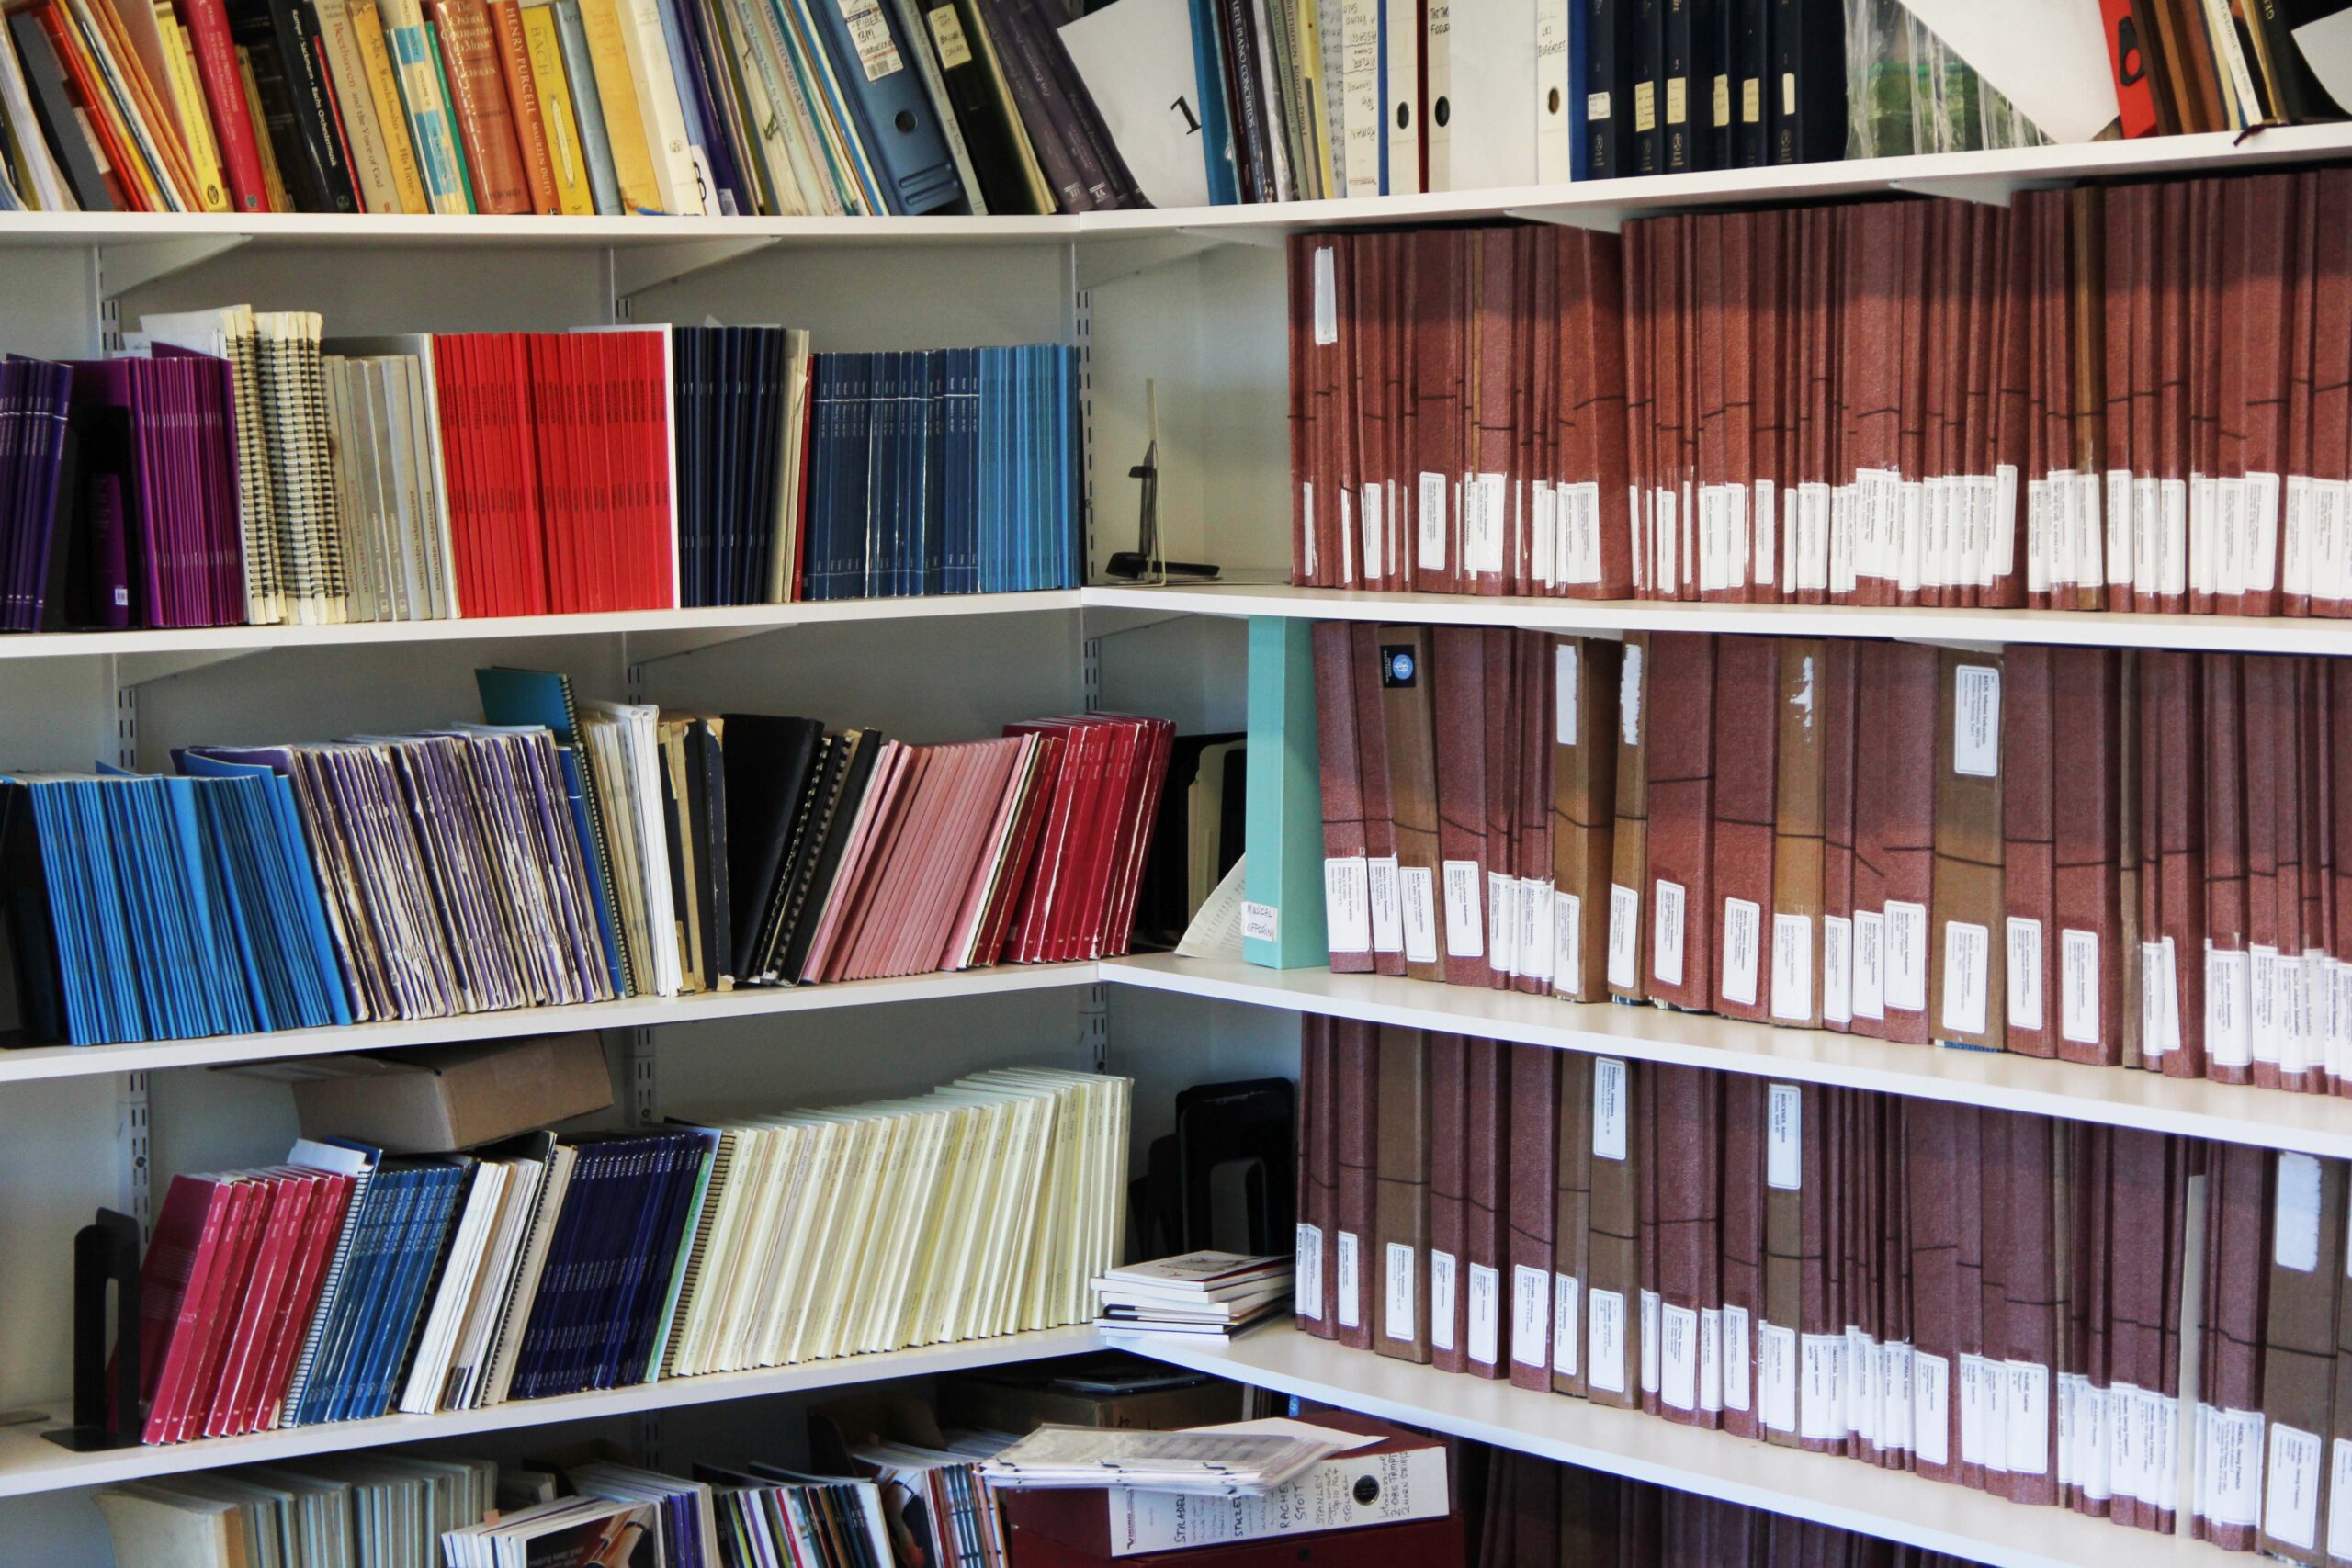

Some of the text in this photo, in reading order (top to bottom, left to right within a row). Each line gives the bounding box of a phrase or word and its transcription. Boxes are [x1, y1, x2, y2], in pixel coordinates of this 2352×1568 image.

[1230, 0, 1242, 25] LETE
[1271, 5, 1286, 57] BEETHOVEN
[1234, 26, 1248, 62] PIANO
[1542, 26, 1552, 38] LES
[525, 26, 554, 77] BACH
[763, 4, 808, 117] COMPLETE CONCERTI GROSSI
[289, 9, 303, 37] Rampe
[300, 41, 315, 80] Sackmann
[311, 85, 323, 108] Bachs
[317, 108, 338, 167] Orchestermusik
[331, 21, 385, 188] Beethoven and the Voice of God
[504, 6, 553, 196] HENRY PURCELL MAUREEN DUFFY
[1238, 63, 1258, 128] CONCERTOS
[1169, 96, 1204, 135] 1
[399, 147, 411, 166] His
[402, 165, 417, 195] Times
[1247, 904, 1272, 918] MUSICAL
[1294, 1483, 1308, 1522] STOTT
[1316, 1474, 1325, 1525] STANLEY
[1388, 1484, 1400, 1506] OBS
[1390, 1507, 1401, 1517] 2
[1398, 1481, 1412, 1506] HORN
[1401, 1506, 1411, 1514] 2
